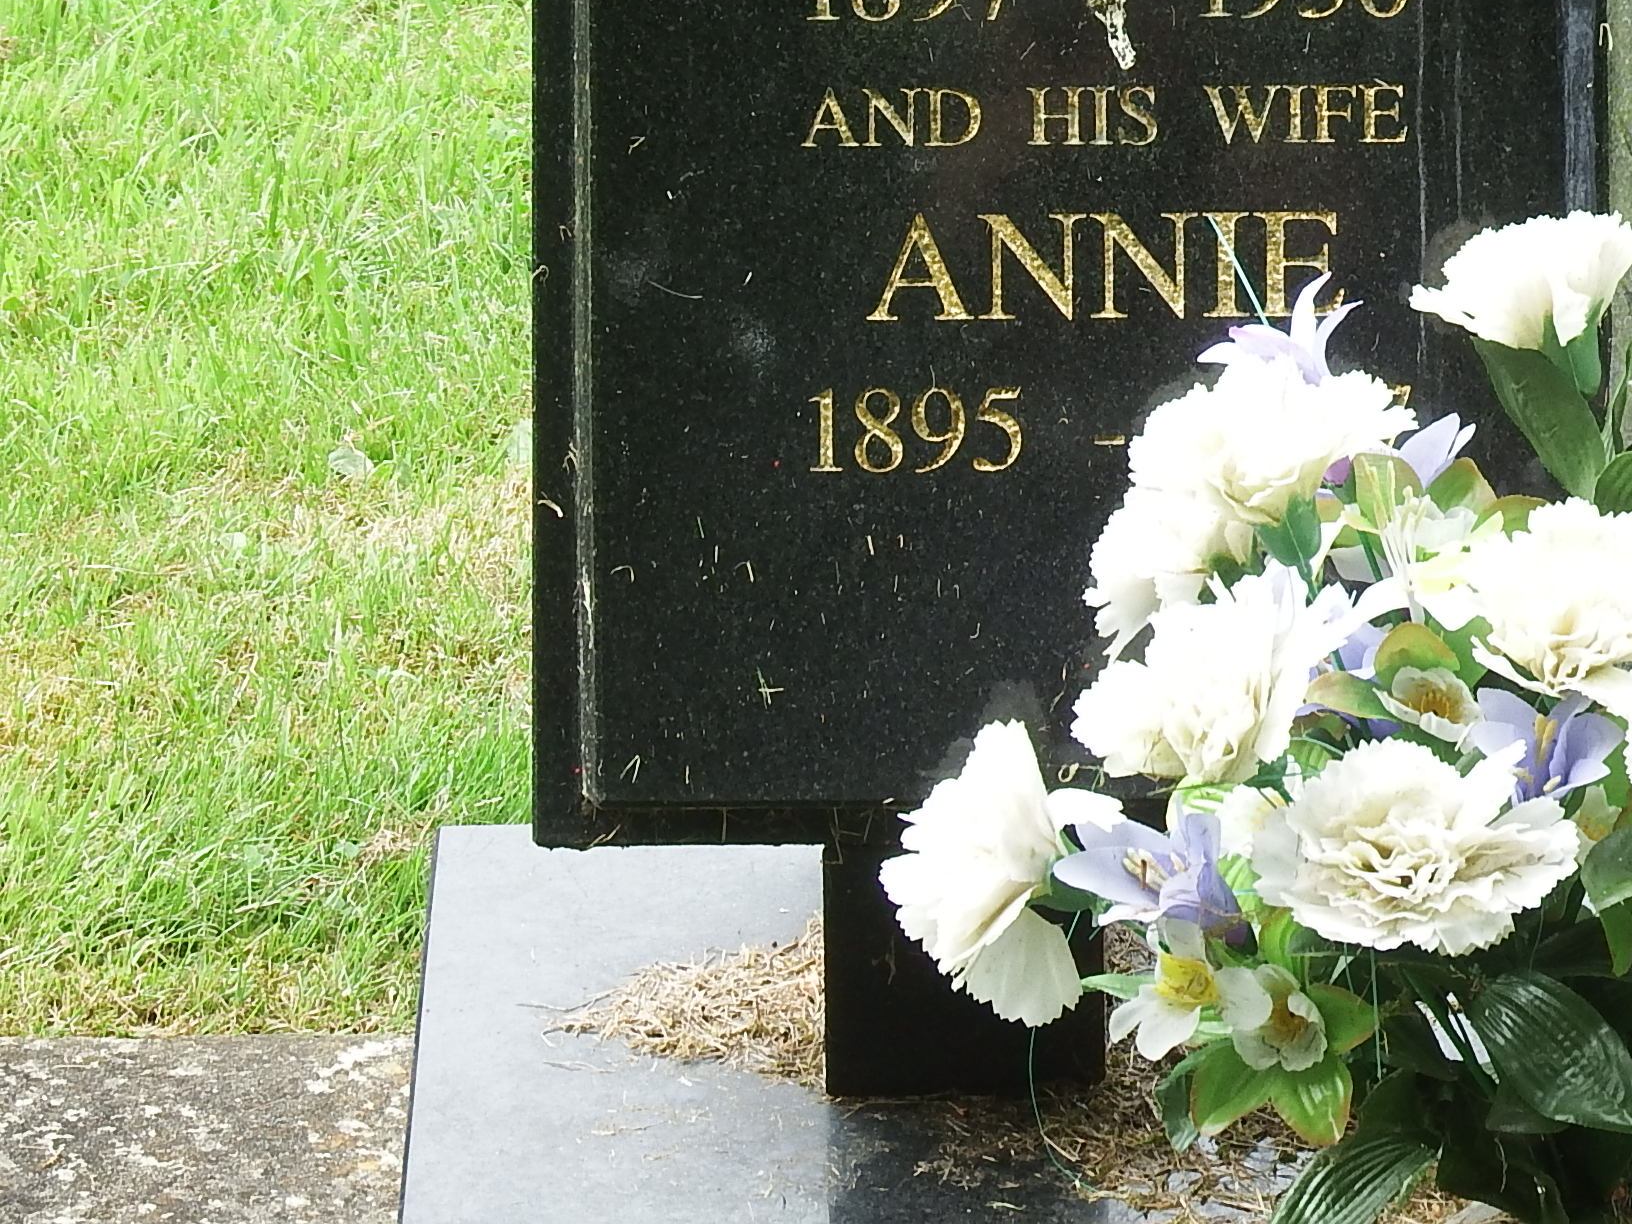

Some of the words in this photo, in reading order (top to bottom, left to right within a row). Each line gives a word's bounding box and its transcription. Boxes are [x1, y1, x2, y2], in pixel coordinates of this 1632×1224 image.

[801, 86, 982, 147] AND
[1027, 86, 1158, 146] HIS
[1203, 84, 1408, 145] WIFE
[866, 210, 1346, 321] ANNIE
[808, 386, 1023, 473] 1895
